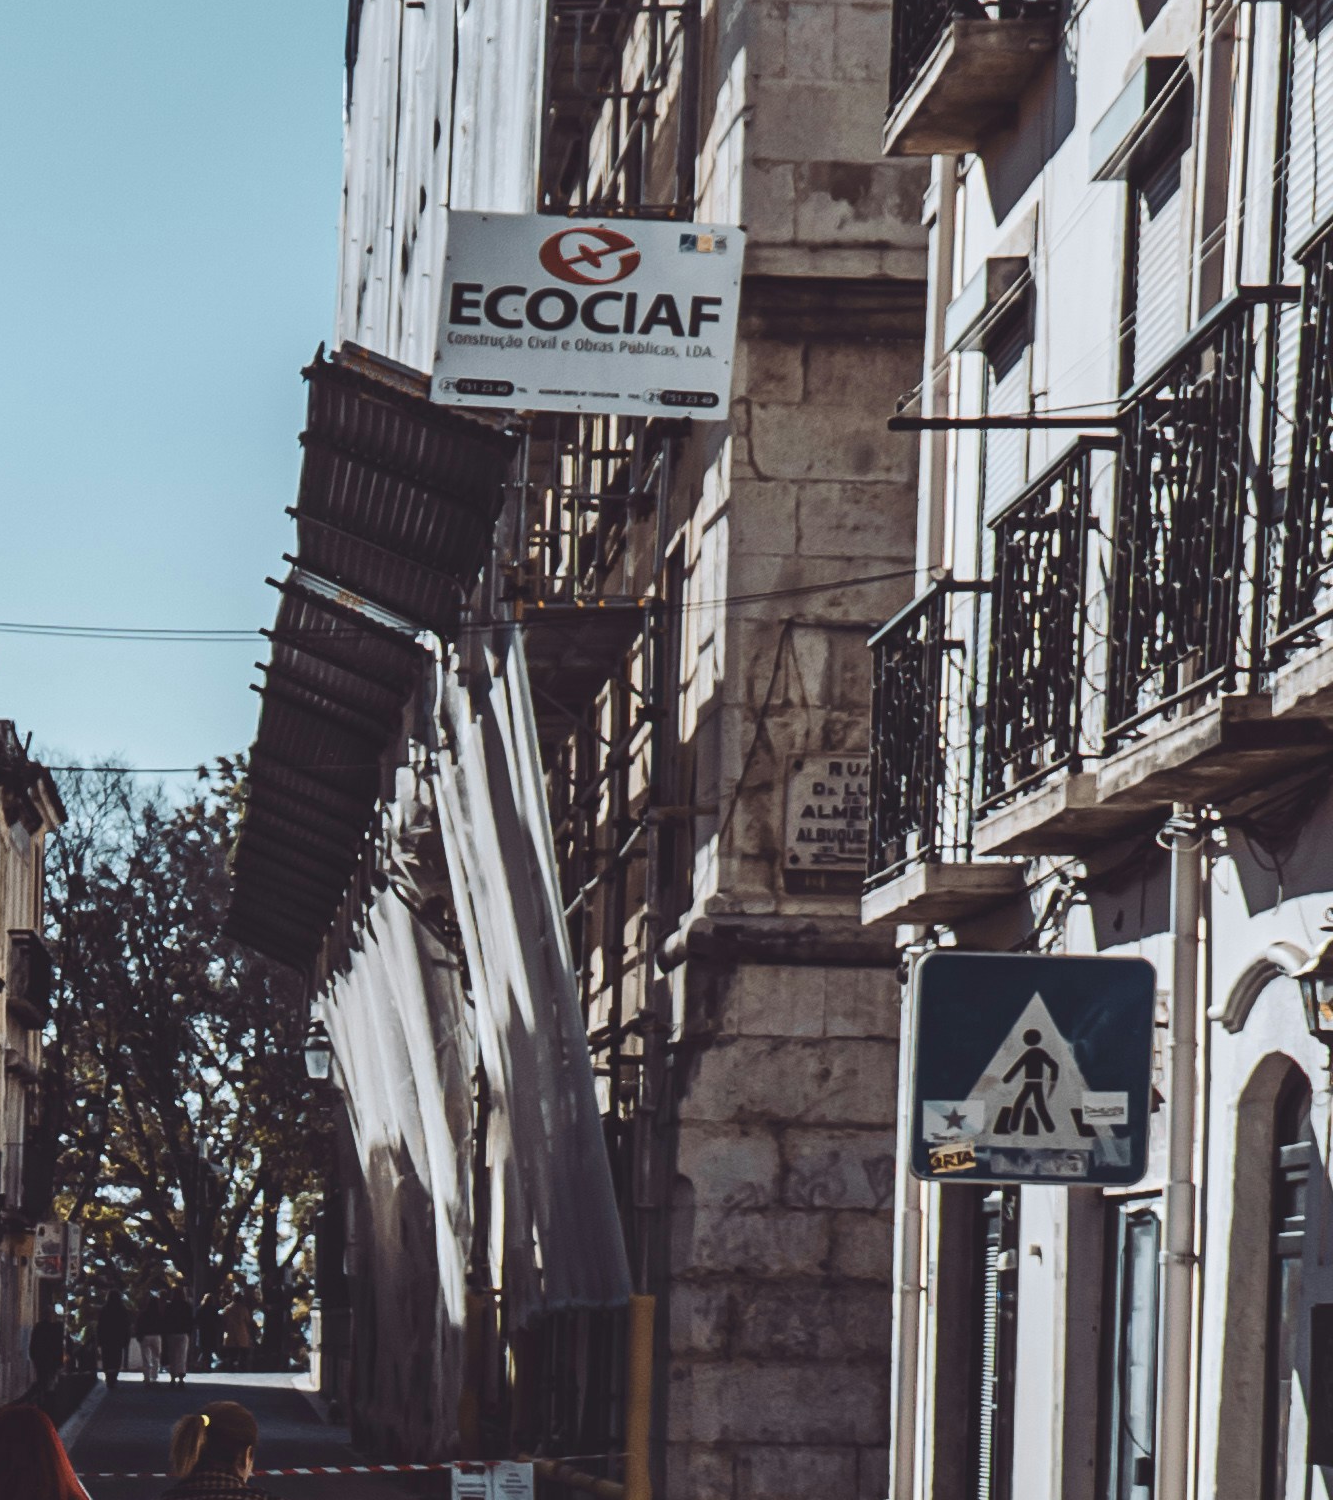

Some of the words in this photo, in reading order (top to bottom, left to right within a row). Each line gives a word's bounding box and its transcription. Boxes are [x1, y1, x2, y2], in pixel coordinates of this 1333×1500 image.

[448, 282, 723, 338] ECOCIAF
[447, 331, 523, 349] Construção
[527, 335, 557, 349] Civil
[561, 339, 570, 351] e
[574, 338, 614, 352] Obras
